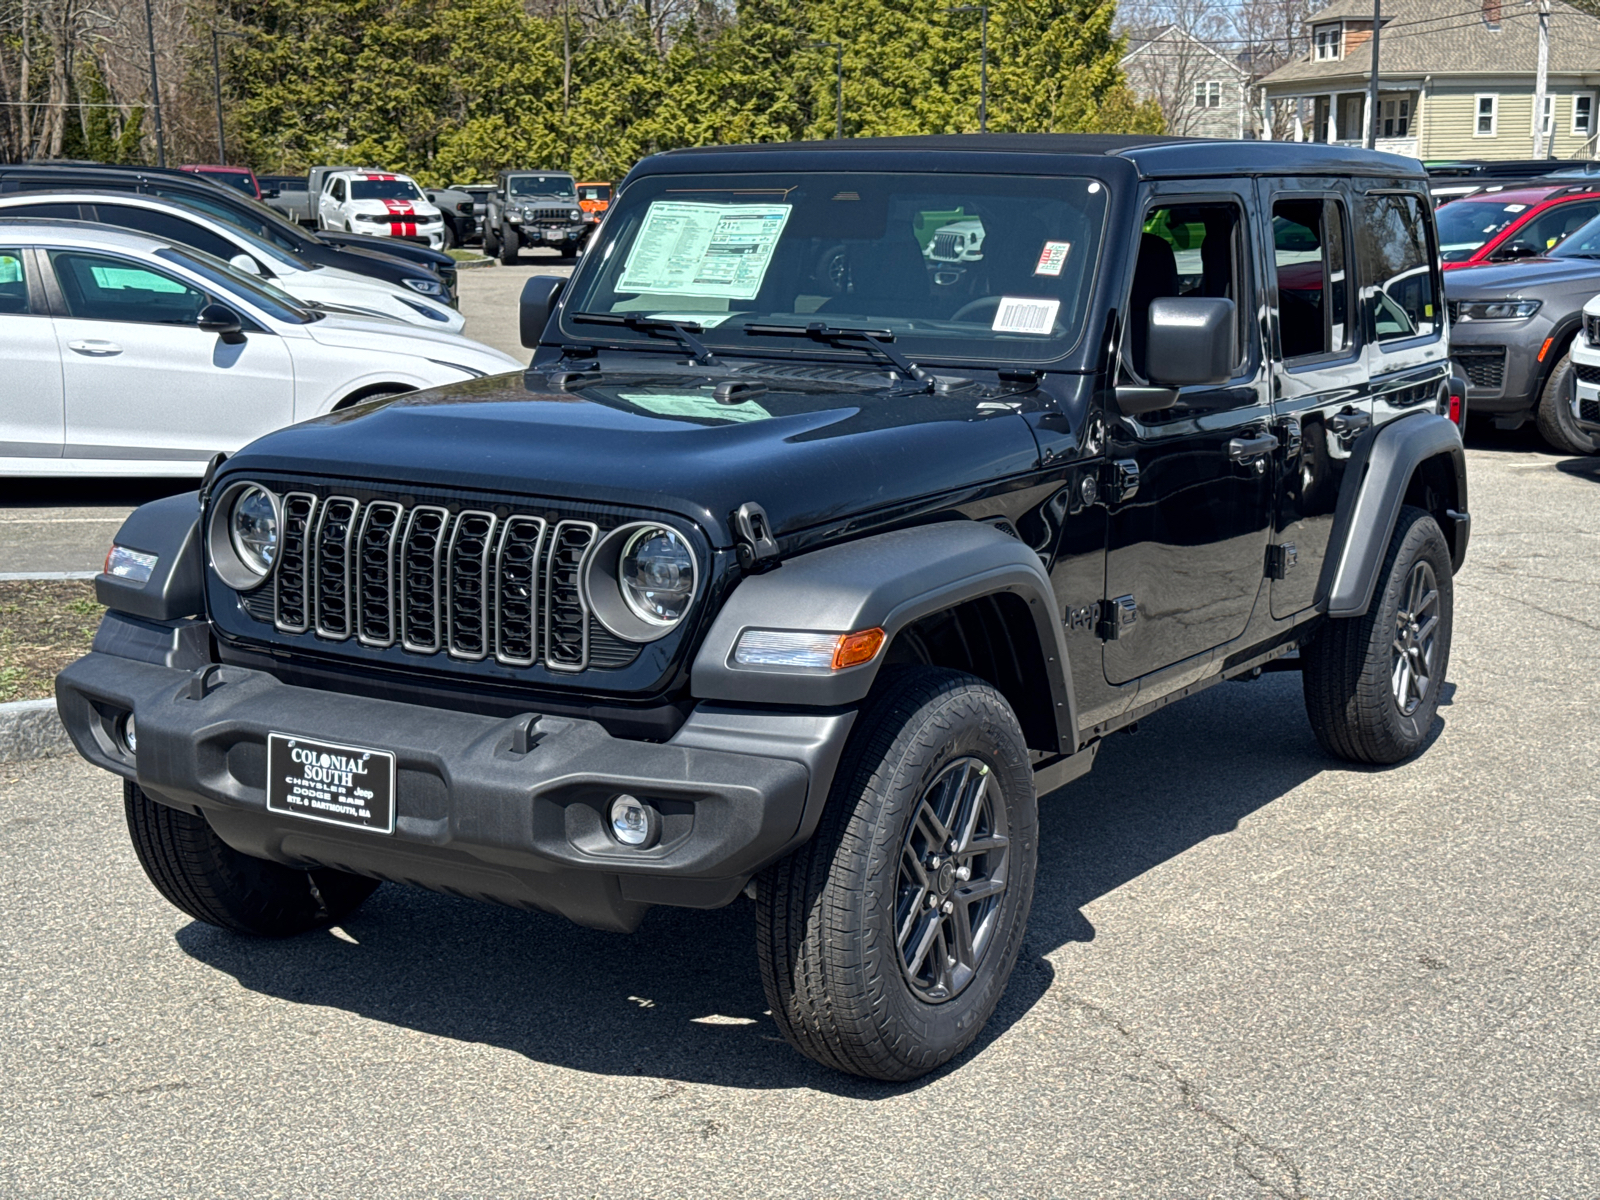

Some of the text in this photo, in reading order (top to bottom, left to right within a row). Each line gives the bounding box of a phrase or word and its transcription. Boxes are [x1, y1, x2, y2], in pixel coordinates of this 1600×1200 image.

[1061, 602, 1101, 631] Jeep
[291, 748, 368, 775] COLONIAL
[304, 764, 353, 787] SOUTH
[285, 776, 374, 800] CHRYSLER Jeep
[293, 786, 365, 806] DODGE RAM
[358, 808, 371, 818] MA
